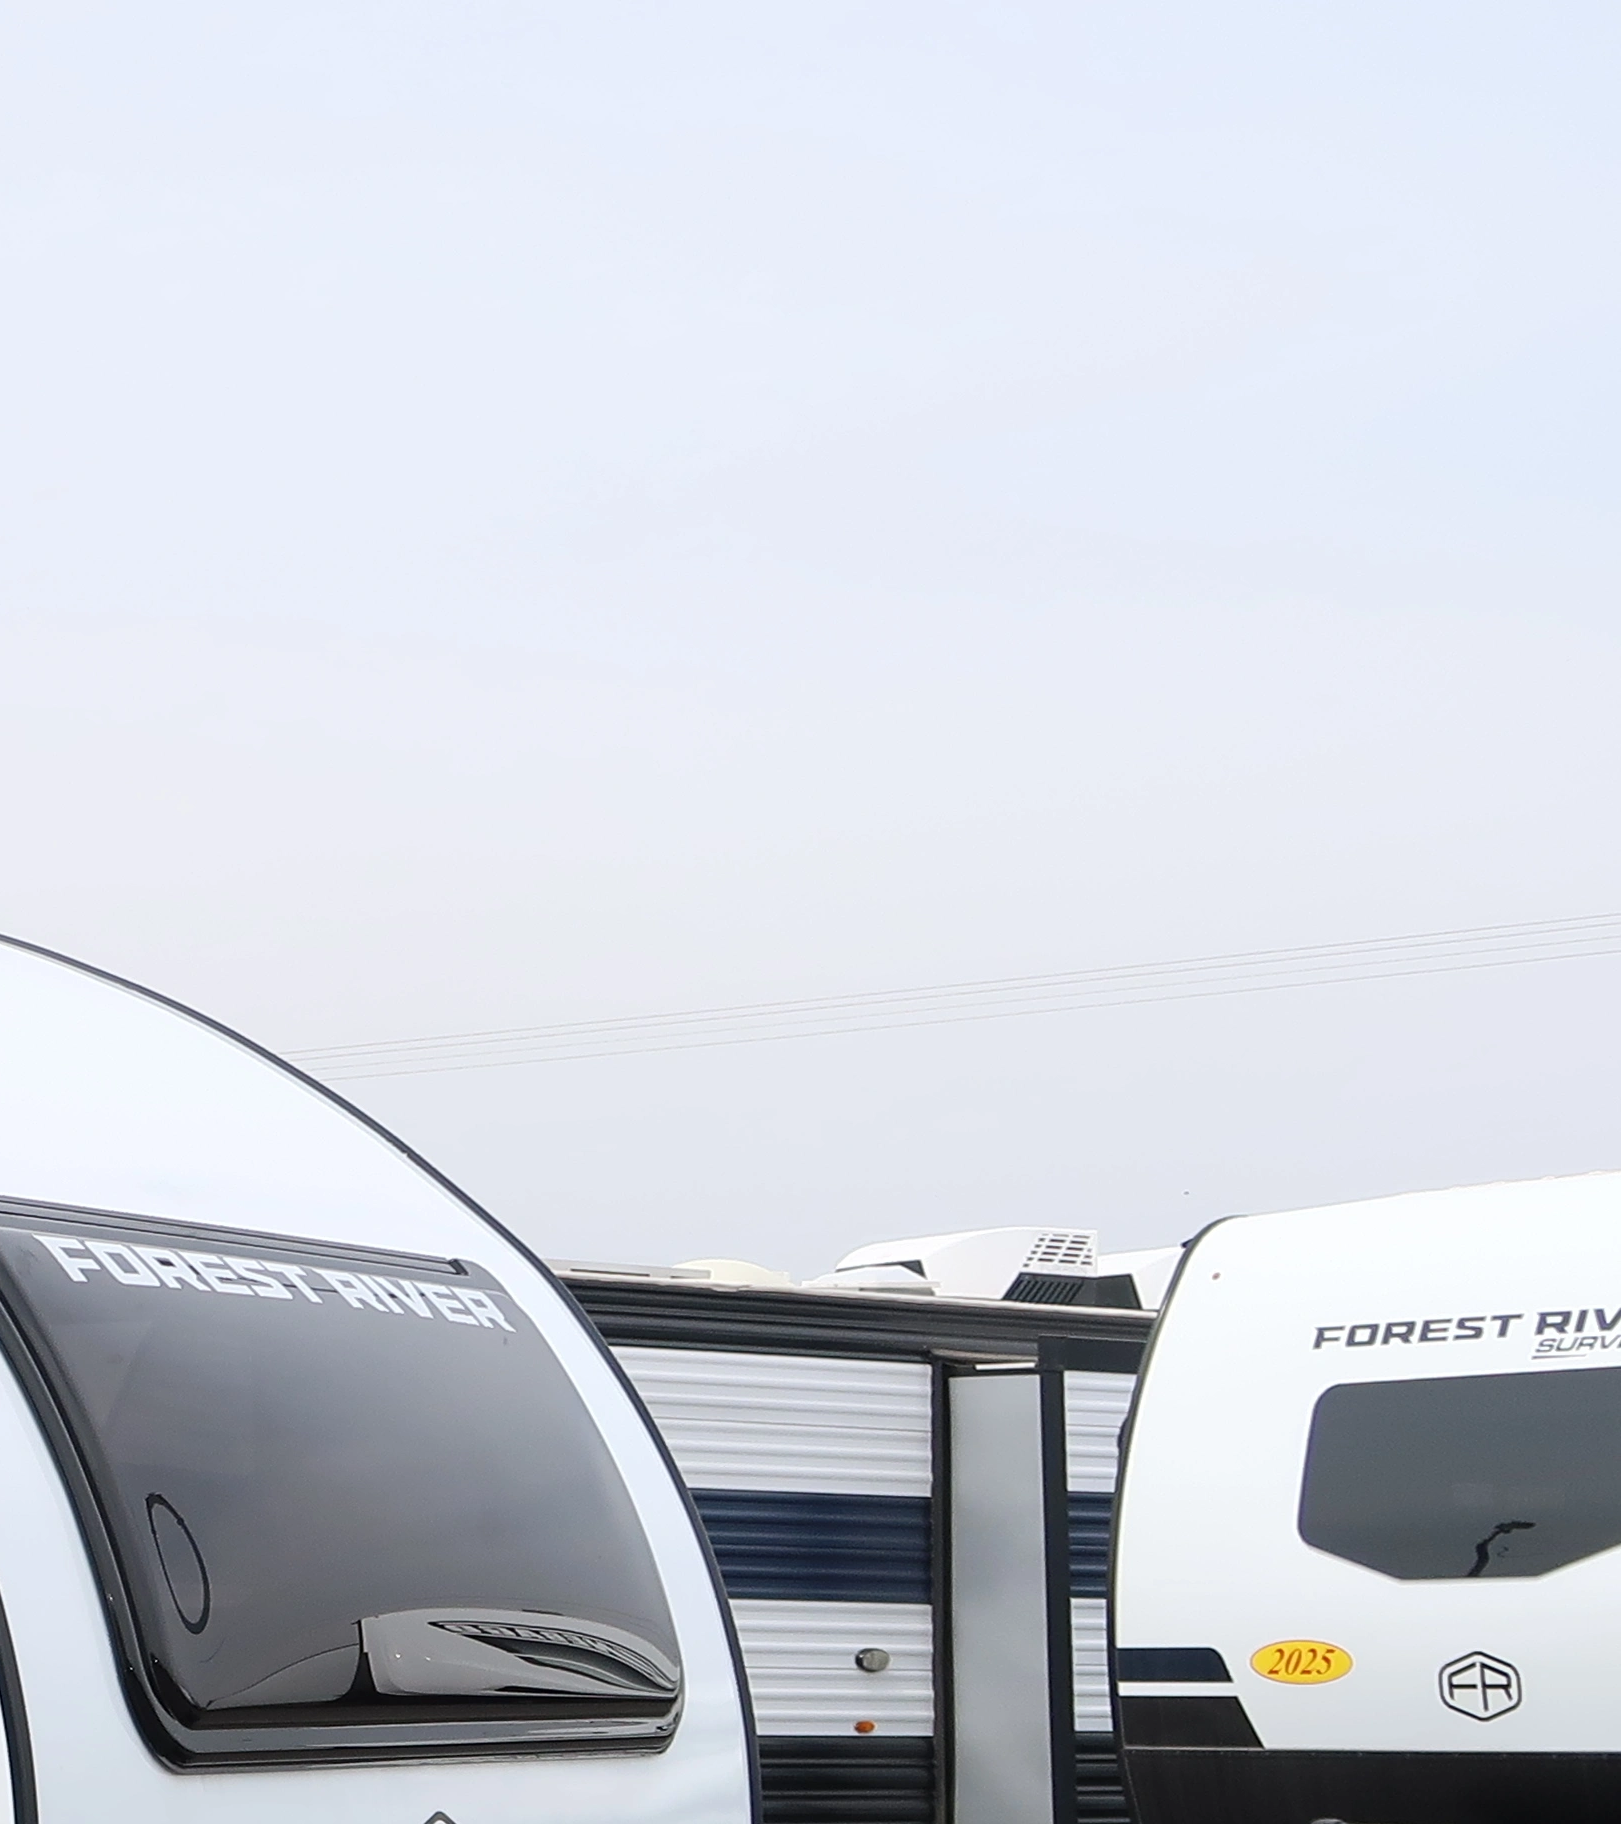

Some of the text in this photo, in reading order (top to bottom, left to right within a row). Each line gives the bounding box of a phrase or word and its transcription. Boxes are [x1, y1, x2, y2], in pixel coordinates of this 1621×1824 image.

[31, 1233, 517, 1334] FOREST RIVER
[1312, 1313, 1523, 1350] FOREST
[1535, 1335, 1621, 1353] SURV
[1267, 1648, 1336, 1675] 2025
